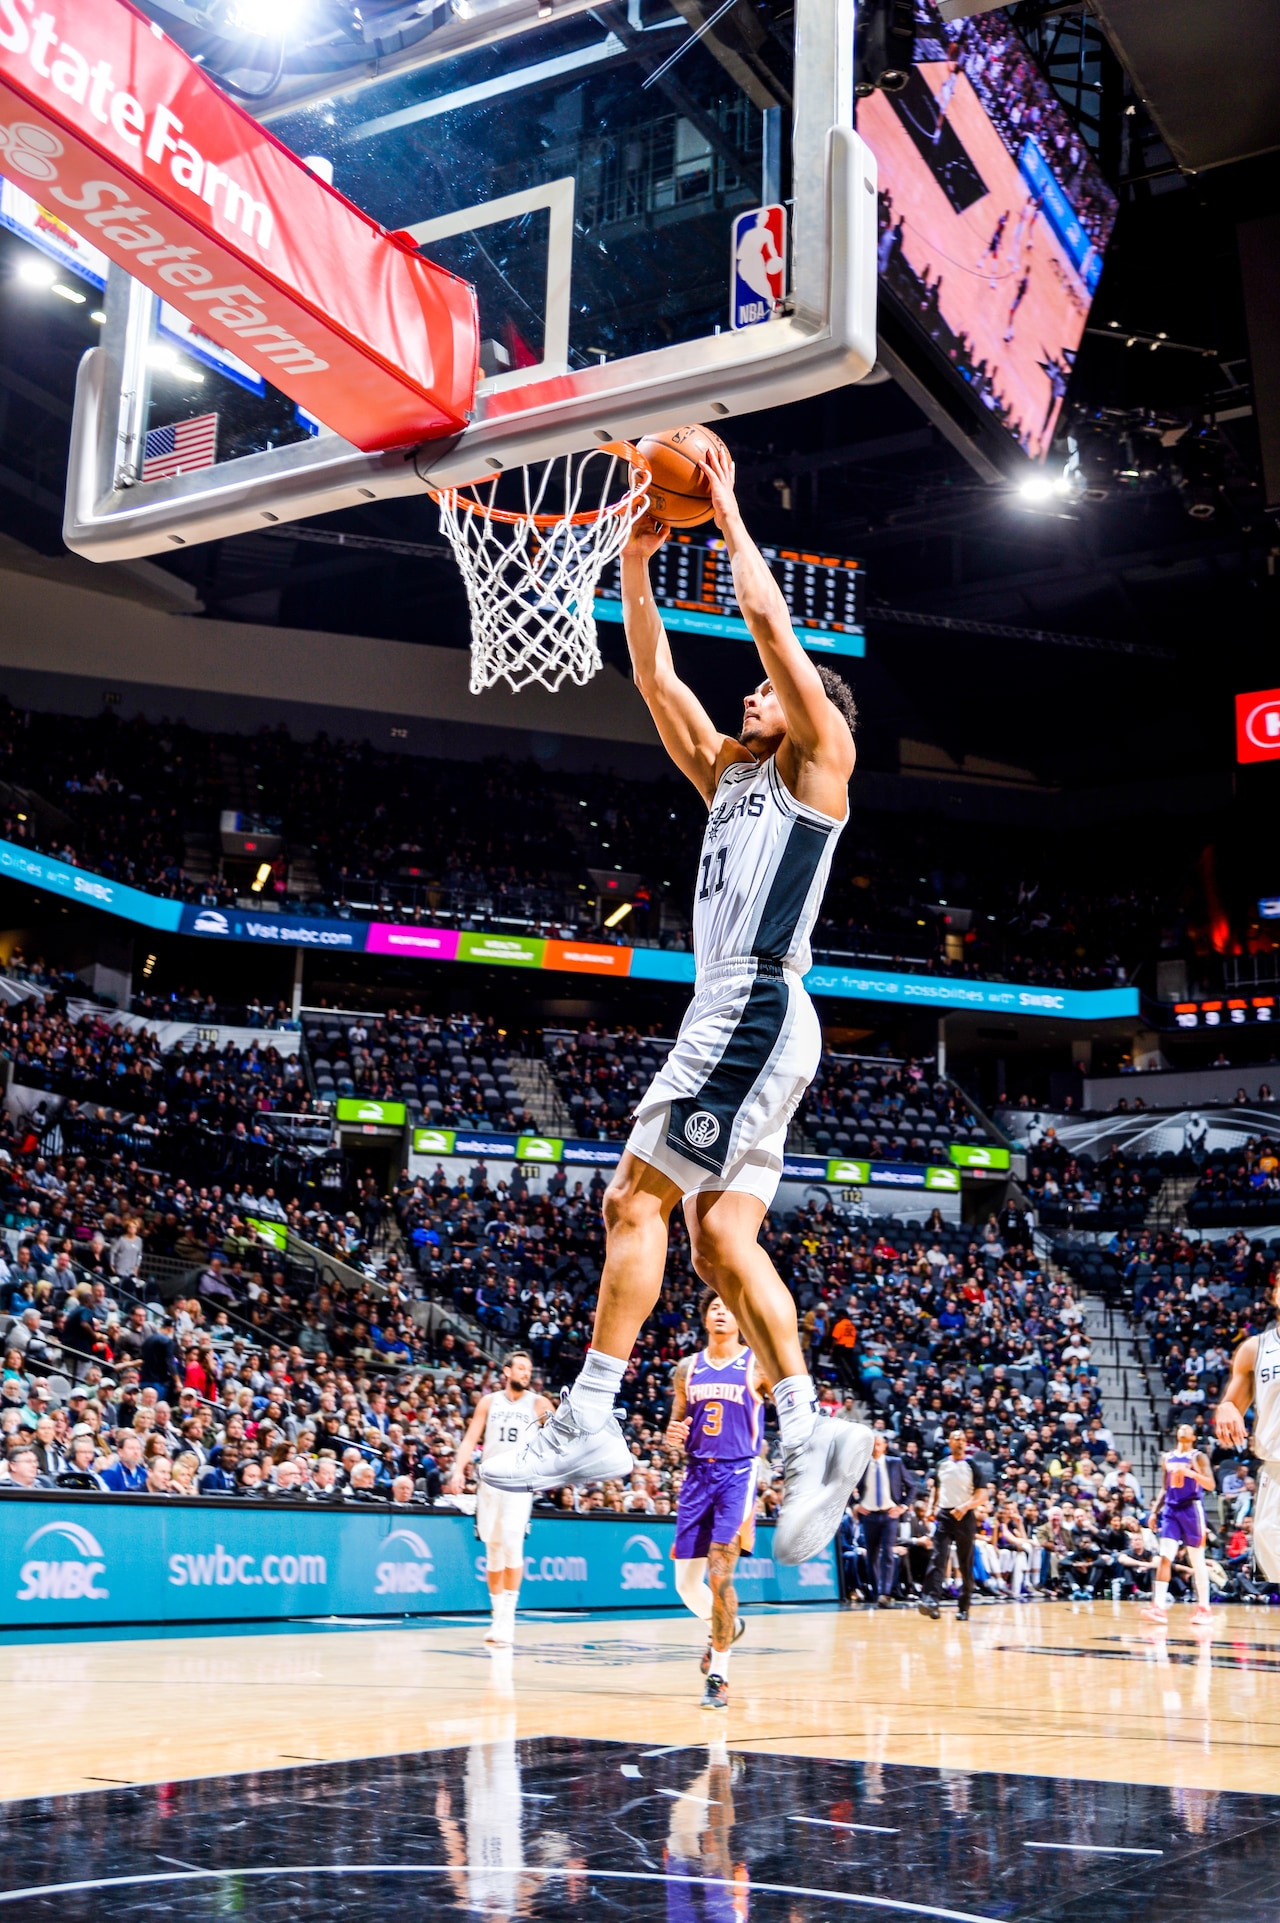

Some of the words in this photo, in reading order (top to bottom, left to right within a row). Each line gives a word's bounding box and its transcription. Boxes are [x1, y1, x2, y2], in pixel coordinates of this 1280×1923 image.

[739, 300, 767, 325] NBA
[698, 845, 730, 902] 11
[1019, 992, 1064, 1009] SWBC
[688, 1383, 746, 1405] PHOENIX
[702, 1401, 724, 1437] 3
[499, 1427, 518, 1442] 18
[169, 1544, 327, 1586] swbc.com
[475, 1556, 588, 1582] sc.com
